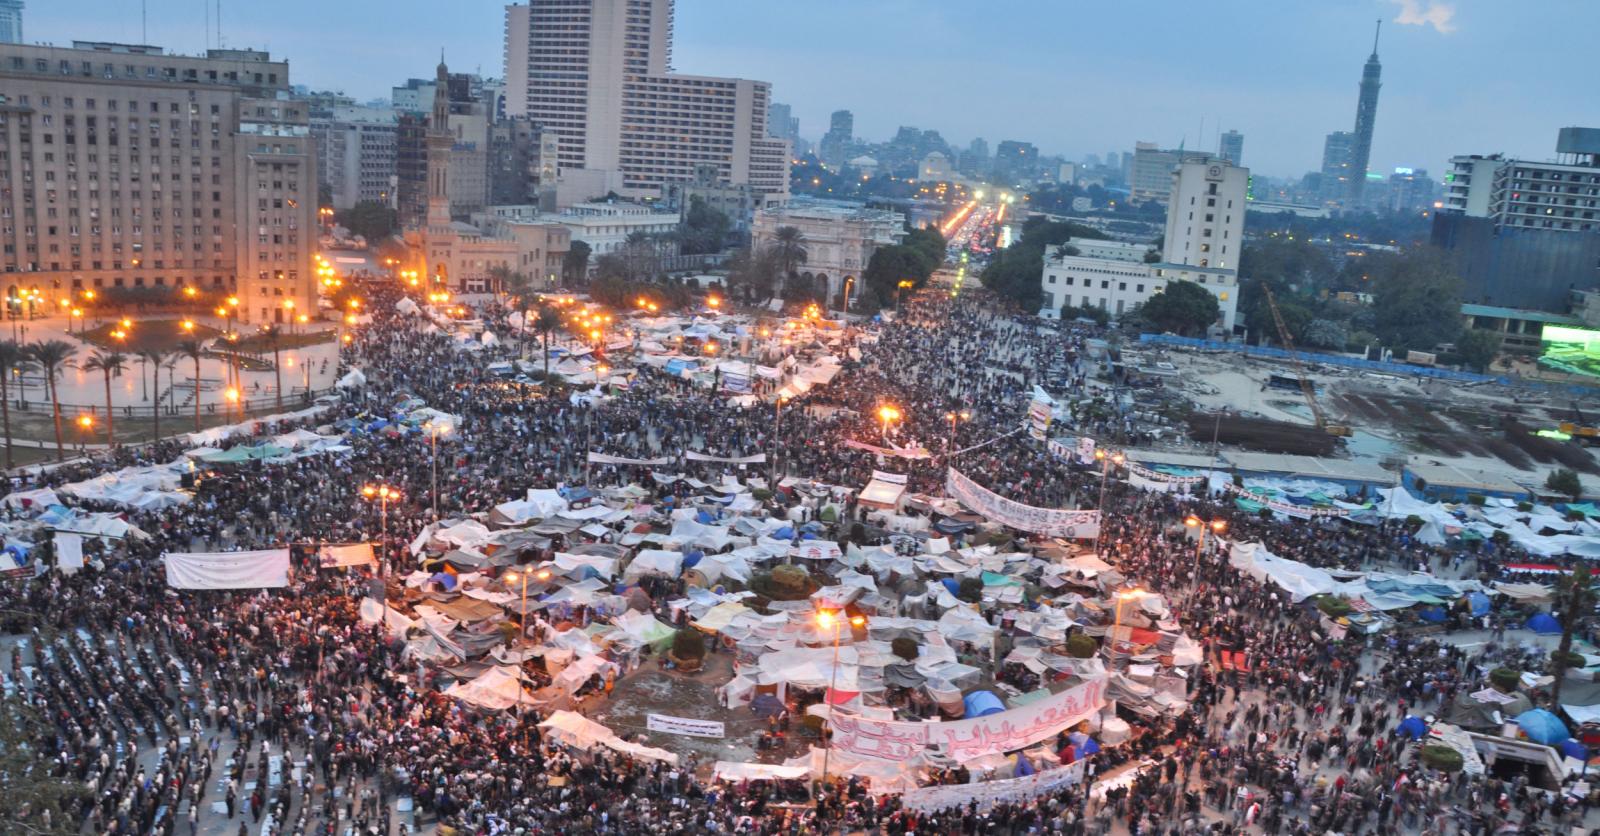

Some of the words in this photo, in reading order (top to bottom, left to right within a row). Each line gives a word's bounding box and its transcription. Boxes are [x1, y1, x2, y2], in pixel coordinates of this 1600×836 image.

[1012, 680, 1101, 744] الشعب
[831, 735, 914, 762] لنظام
[943, 719, 1015, 758] يريد
